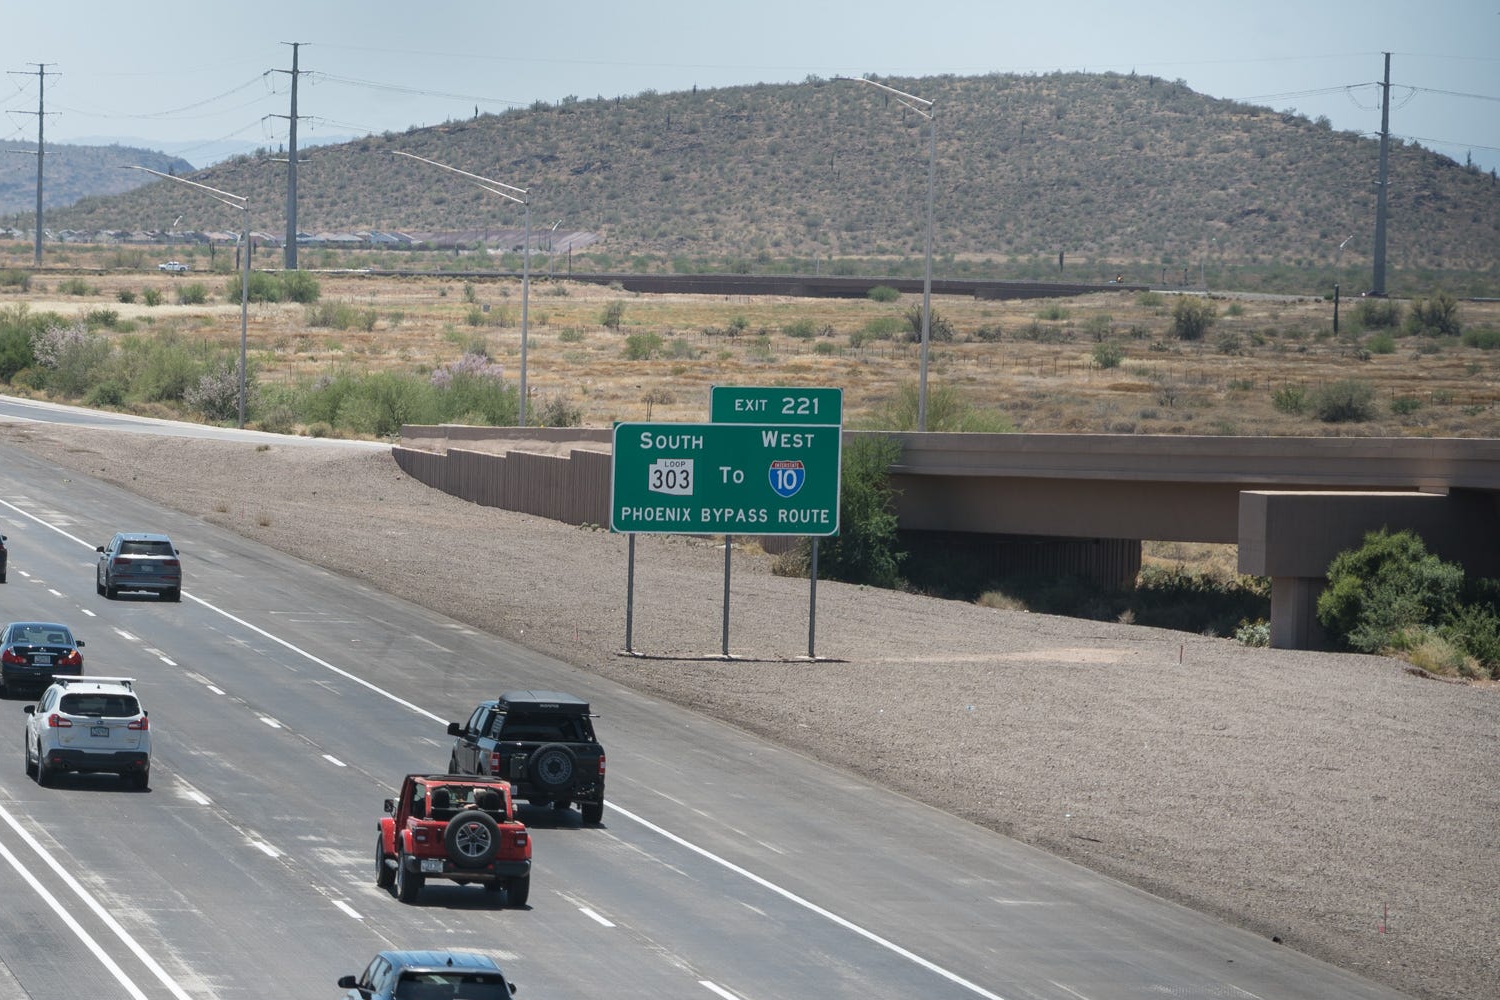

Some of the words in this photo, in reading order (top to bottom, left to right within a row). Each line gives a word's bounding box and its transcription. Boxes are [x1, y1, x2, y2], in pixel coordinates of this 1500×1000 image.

[734, 399, 768, 412] EXIT
[781, 397, 819, 415] 221
[640, 431, 703, 450] SOUTH
[761, 430, 814, 448] WEST
[664, 460, 686, 468] LOOP
[652, 469, 690, 489] 303
[777, 469, 797, 490] 10
[621, 507, 691, 522] PHOENIX
[701, 508, 768, 523] BYPASS
[778, 509, 830, 524] ROUTE
